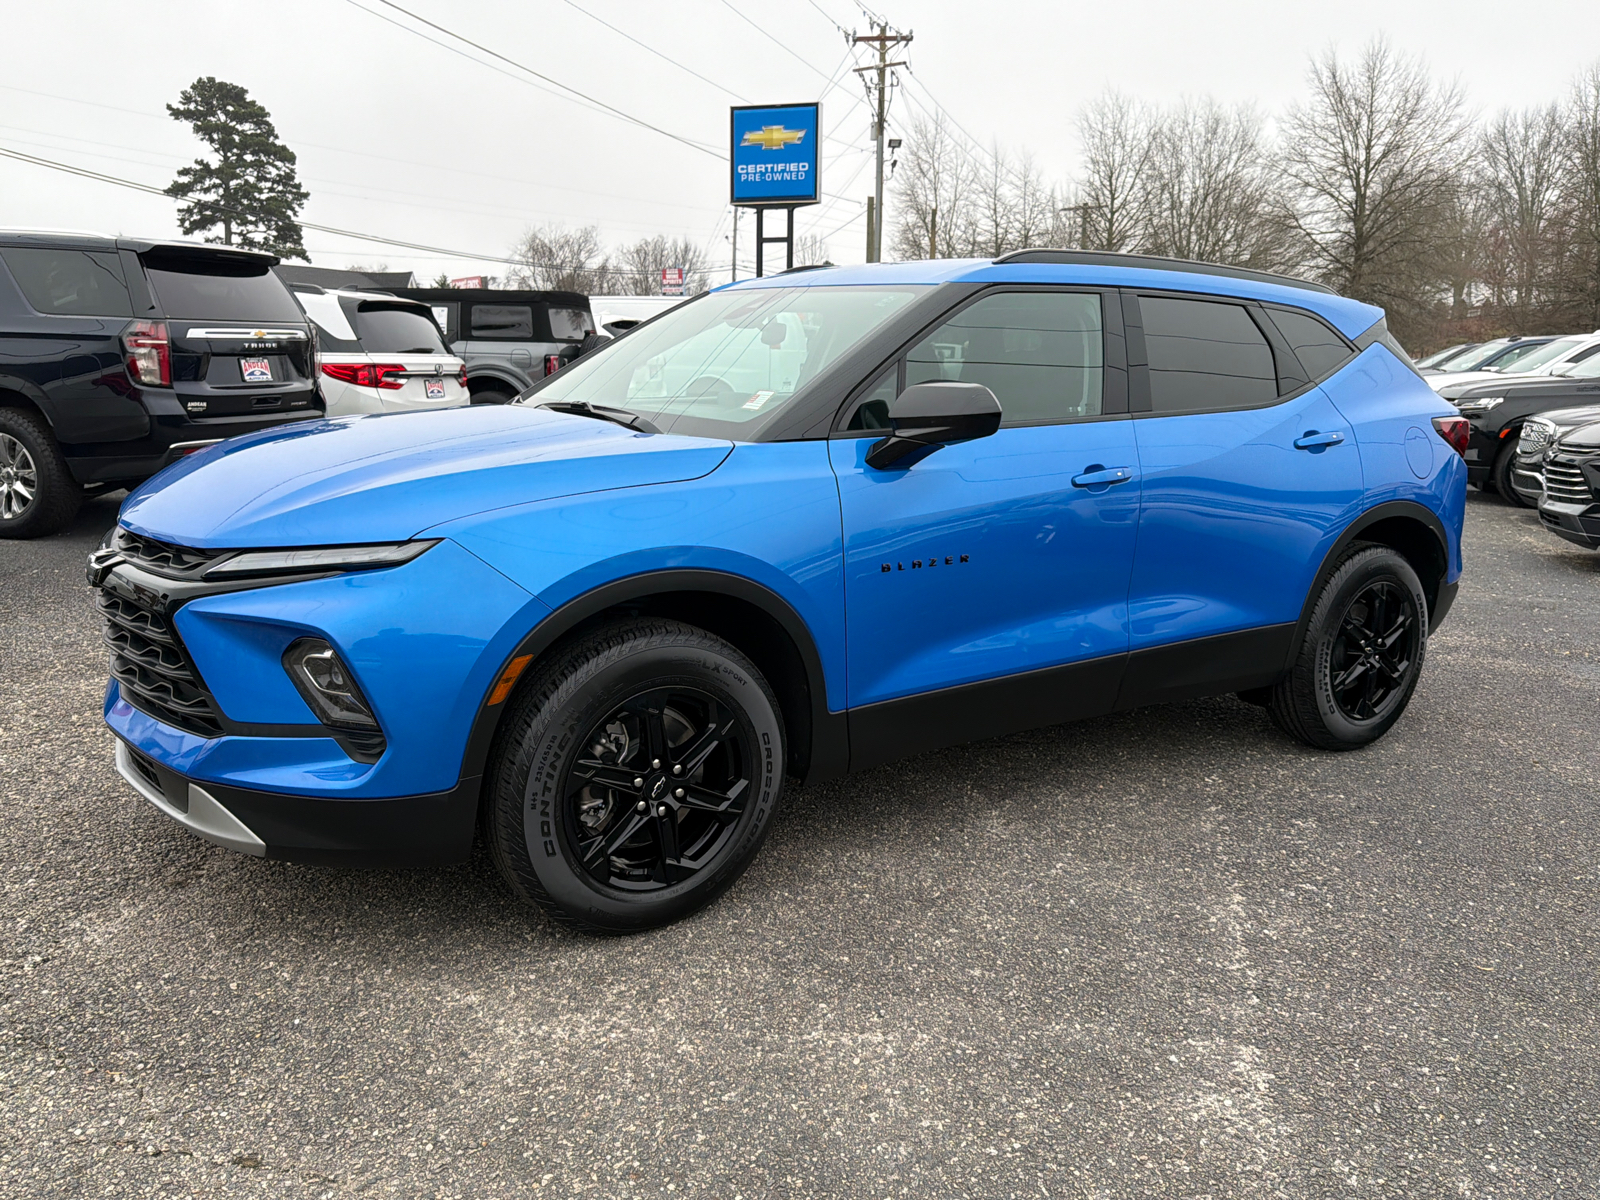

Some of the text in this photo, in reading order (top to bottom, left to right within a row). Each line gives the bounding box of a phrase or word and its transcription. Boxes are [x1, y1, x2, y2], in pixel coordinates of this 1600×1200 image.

[738, 162, 809, 173] CERTIFIED
[741, 172, 805, 182] PRE-OWNED
[243, 361, 270, 374] ANDEAN
[881, 553, 970, 573] BLAZER
[722, 666, 748, 686] SPORT
[534, 734, 558, 783] 235/65R18
[762, 732, 773, 803] CROSS
